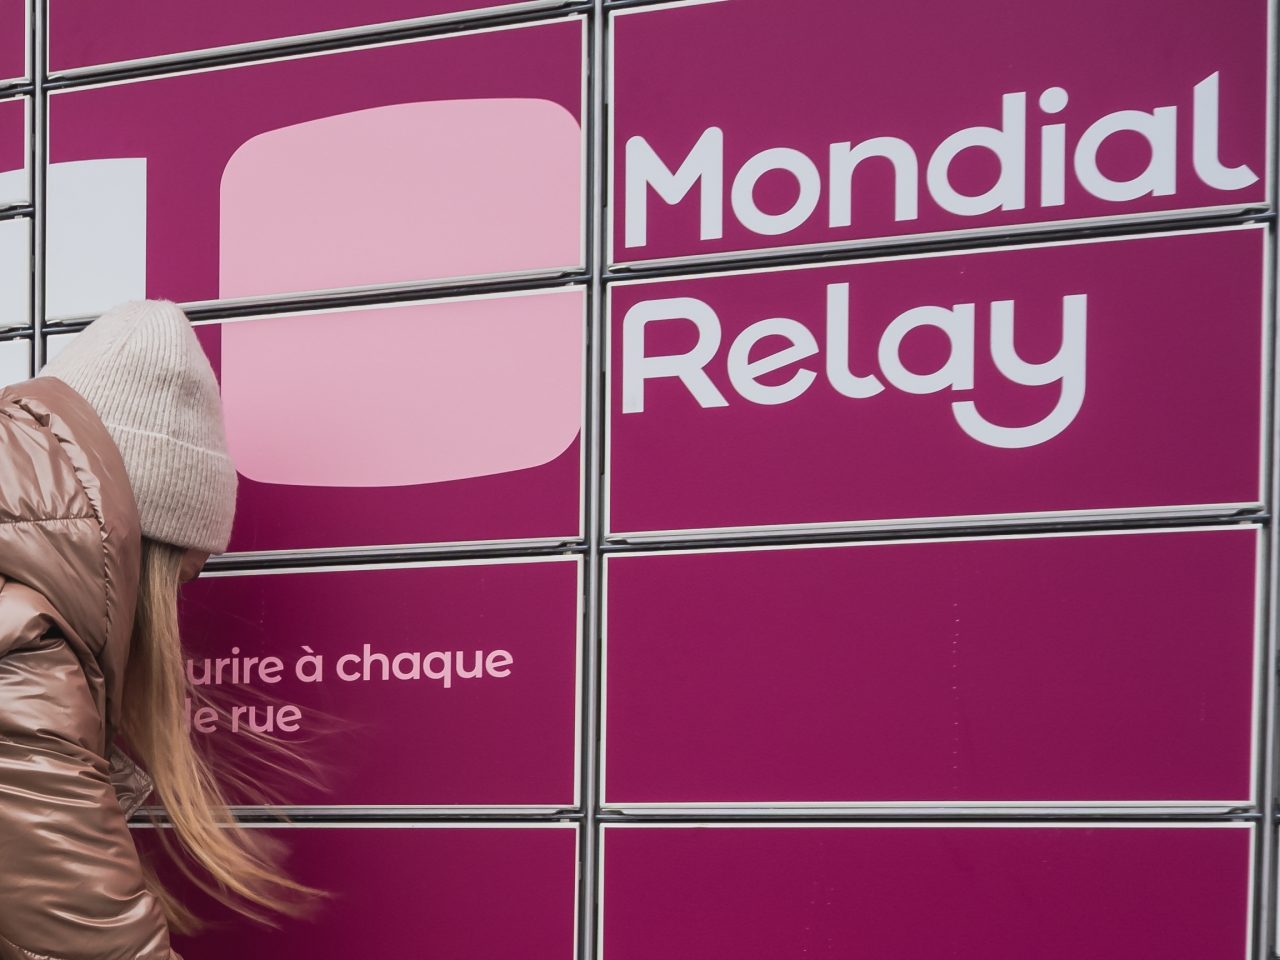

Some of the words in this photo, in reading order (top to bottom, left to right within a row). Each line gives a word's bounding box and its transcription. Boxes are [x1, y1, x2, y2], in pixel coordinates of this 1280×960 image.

[625, 70, 1259, 248] Mondial
[623, 282, 1087, 449] Relay
[186, 646, 284, 685] urire
[295, 645, 323, 683] à
[336, 643, 514, 688] chaque
[231, 704, 302, 733] rue
